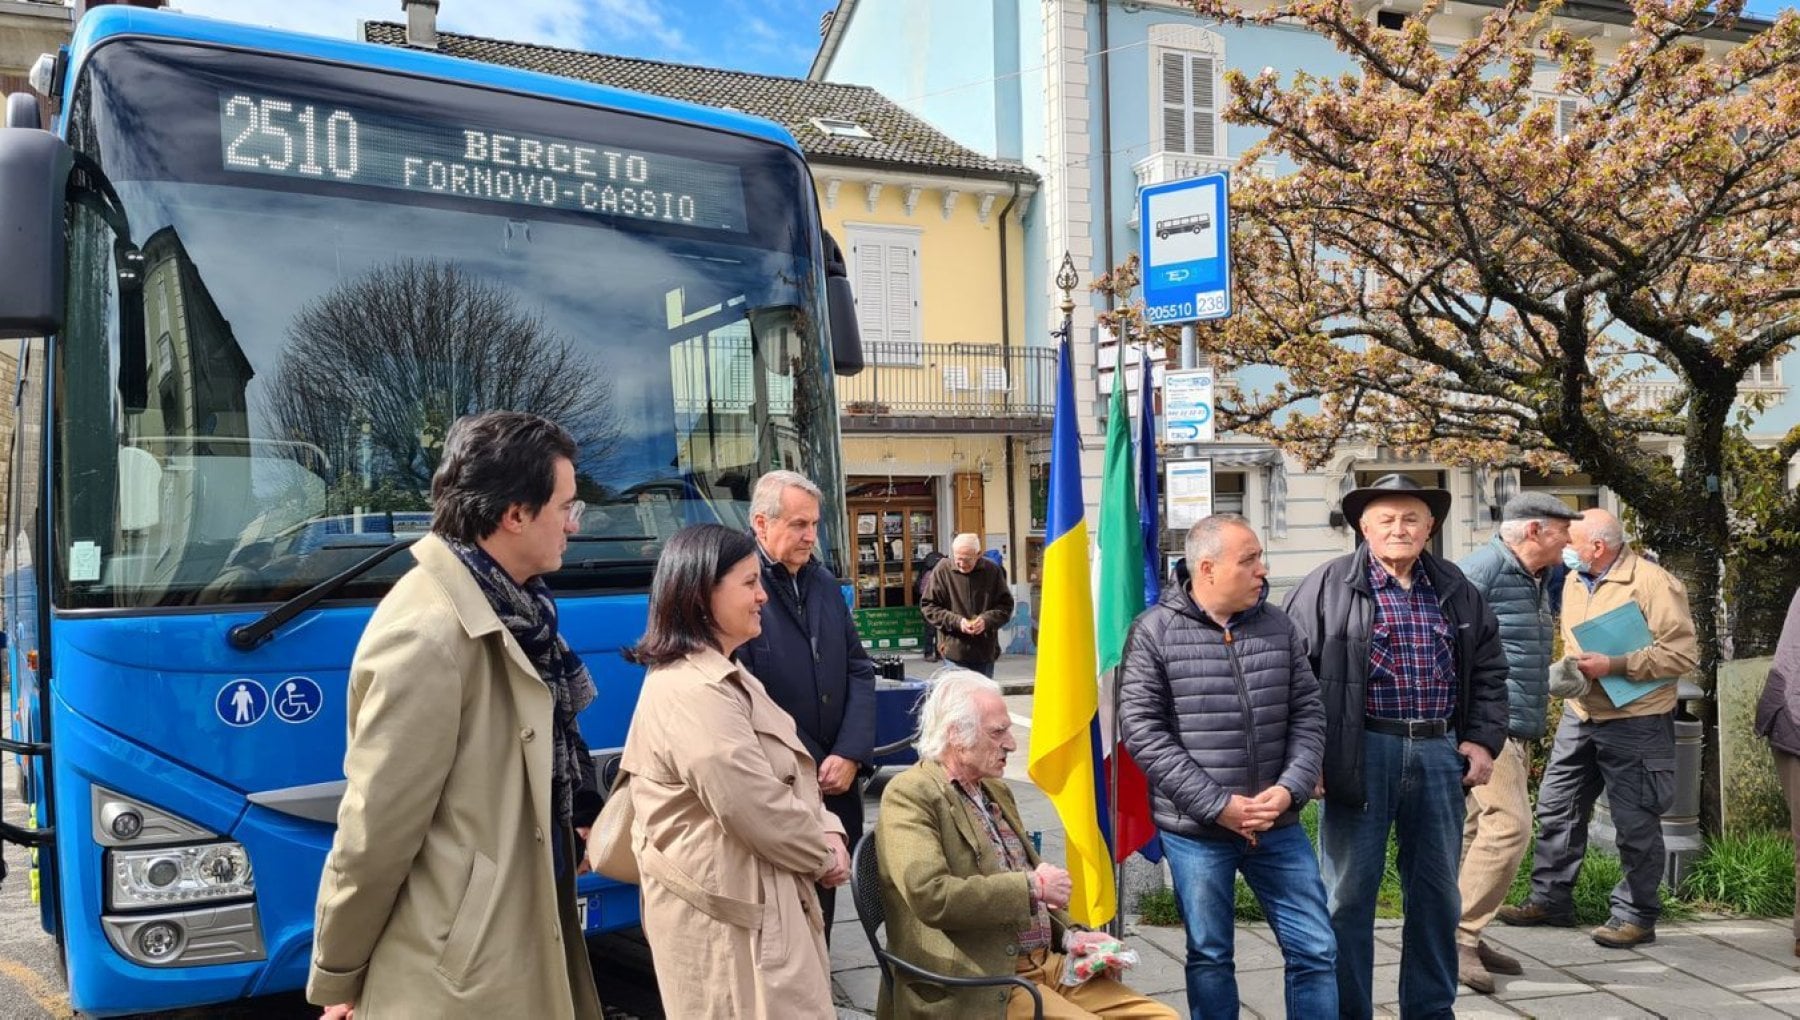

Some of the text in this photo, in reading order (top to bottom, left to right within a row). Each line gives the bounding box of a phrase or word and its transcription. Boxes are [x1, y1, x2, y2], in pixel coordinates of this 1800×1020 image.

[226, 95, 358, 179] 2510
[463, 128, 649, 183] BERCETO
[404, 155, 695, 222] FORNOVO-CASSIO
[1149, 302, 1192, 320] 205510
[1198, 296, 1224, 313] 238
